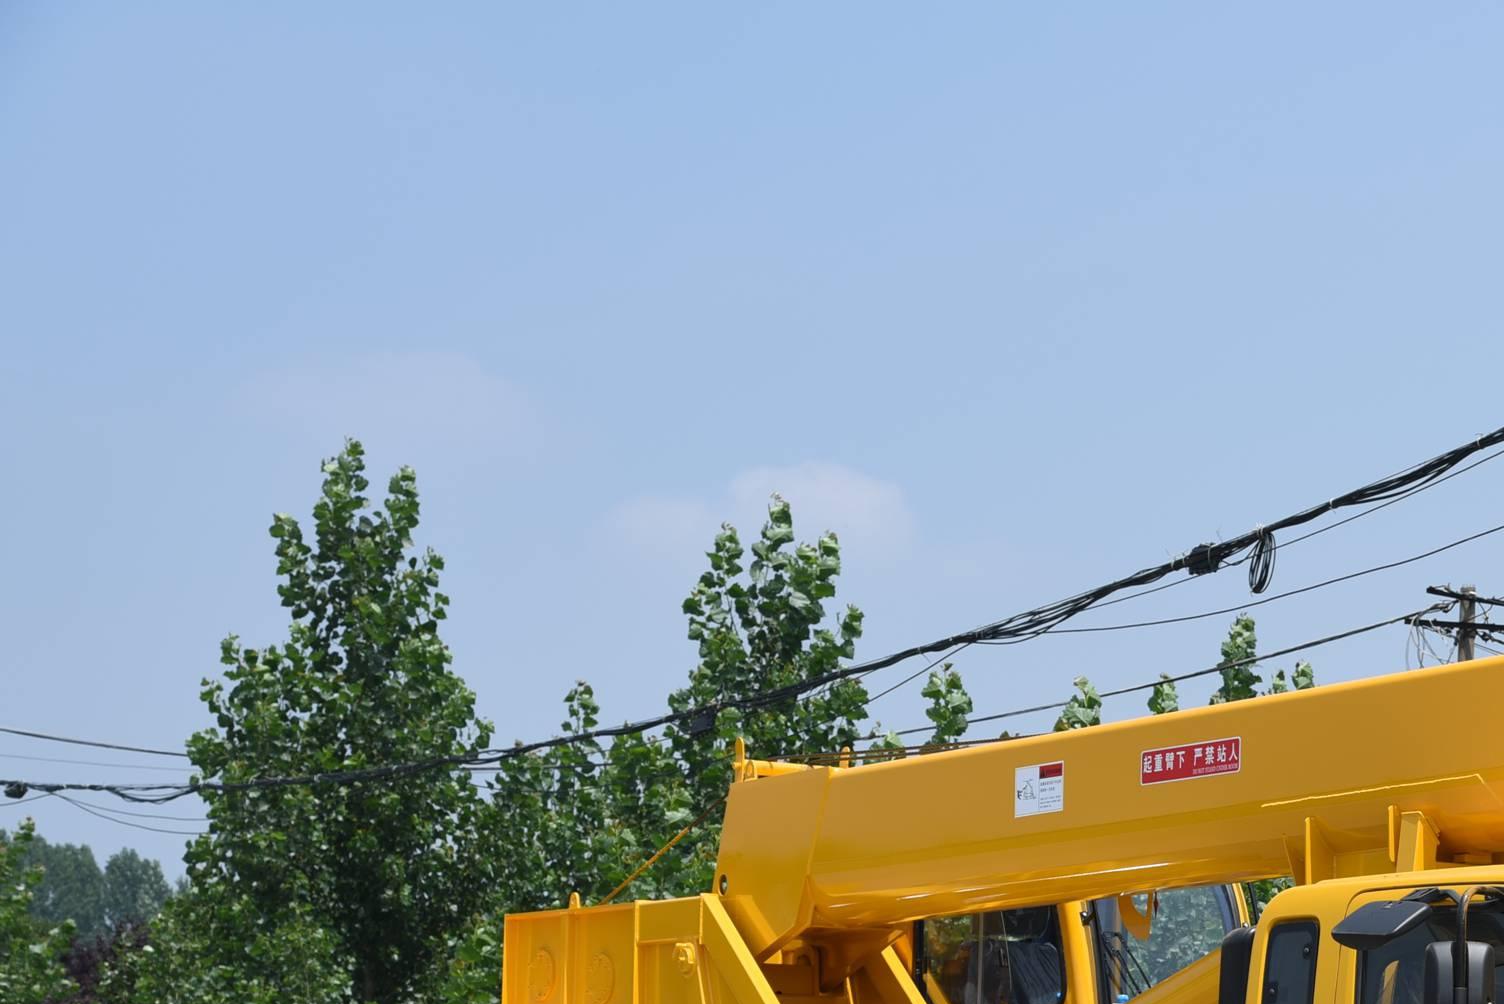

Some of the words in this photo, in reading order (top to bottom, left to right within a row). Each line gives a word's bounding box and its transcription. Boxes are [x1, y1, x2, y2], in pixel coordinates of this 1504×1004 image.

[1143, 751, 1186, 773] 起重臂下
[1193, 742, 1238, 767] 严禁站人
